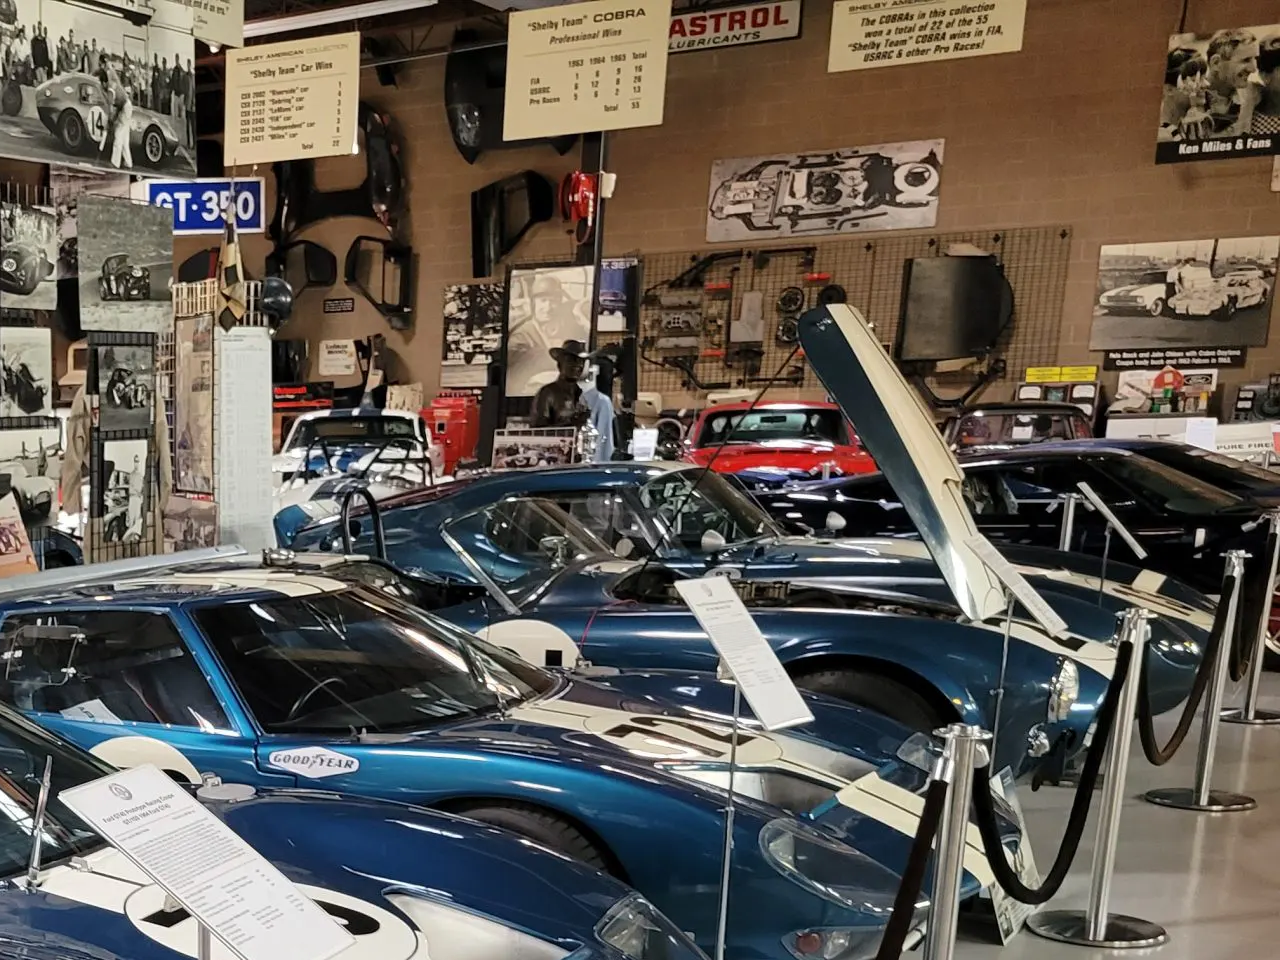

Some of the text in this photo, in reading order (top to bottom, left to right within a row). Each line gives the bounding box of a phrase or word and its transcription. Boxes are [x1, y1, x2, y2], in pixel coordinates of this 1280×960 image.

[593, 8, 646, 23] COBRA
[848, 2, 887, 12] SHELBY
[861, 4, 995, 27] The COBRAs in this collection
[669, 5, 789, 38] ASTROL
[864, 30, 883, 38] won
[894, 25, 915, 35] total
[918, 24, 928, 33] of
[930, 20, 942, 31] 22
[945, 18, 954, 29] of
[957, 17, 973, 27] the
[975, 14, 988, 25] 55
[549, 28, 622, 45] Professional Wins
[668, 31, 761, 50] LUBRICANTS
[915, 32, 946, 44] COBRA
[949, 30, 971, 41] wins
[974, 27, 983, 37] in
[266, 49, 304, 59] AMERICAN
[863, 51, 894, 62] USRRC
[906, 47, 931, 58] other
[933, 44, 949, 54] Pro
[952, 40, 985, 52] Races!
[301, 63, 314, 73] Car
[90, 110, 105, 137] 14
[1179, 138, 1272, 154] Ken Miles & Fans
[273, 754, 354, 768] GOODYEAR
